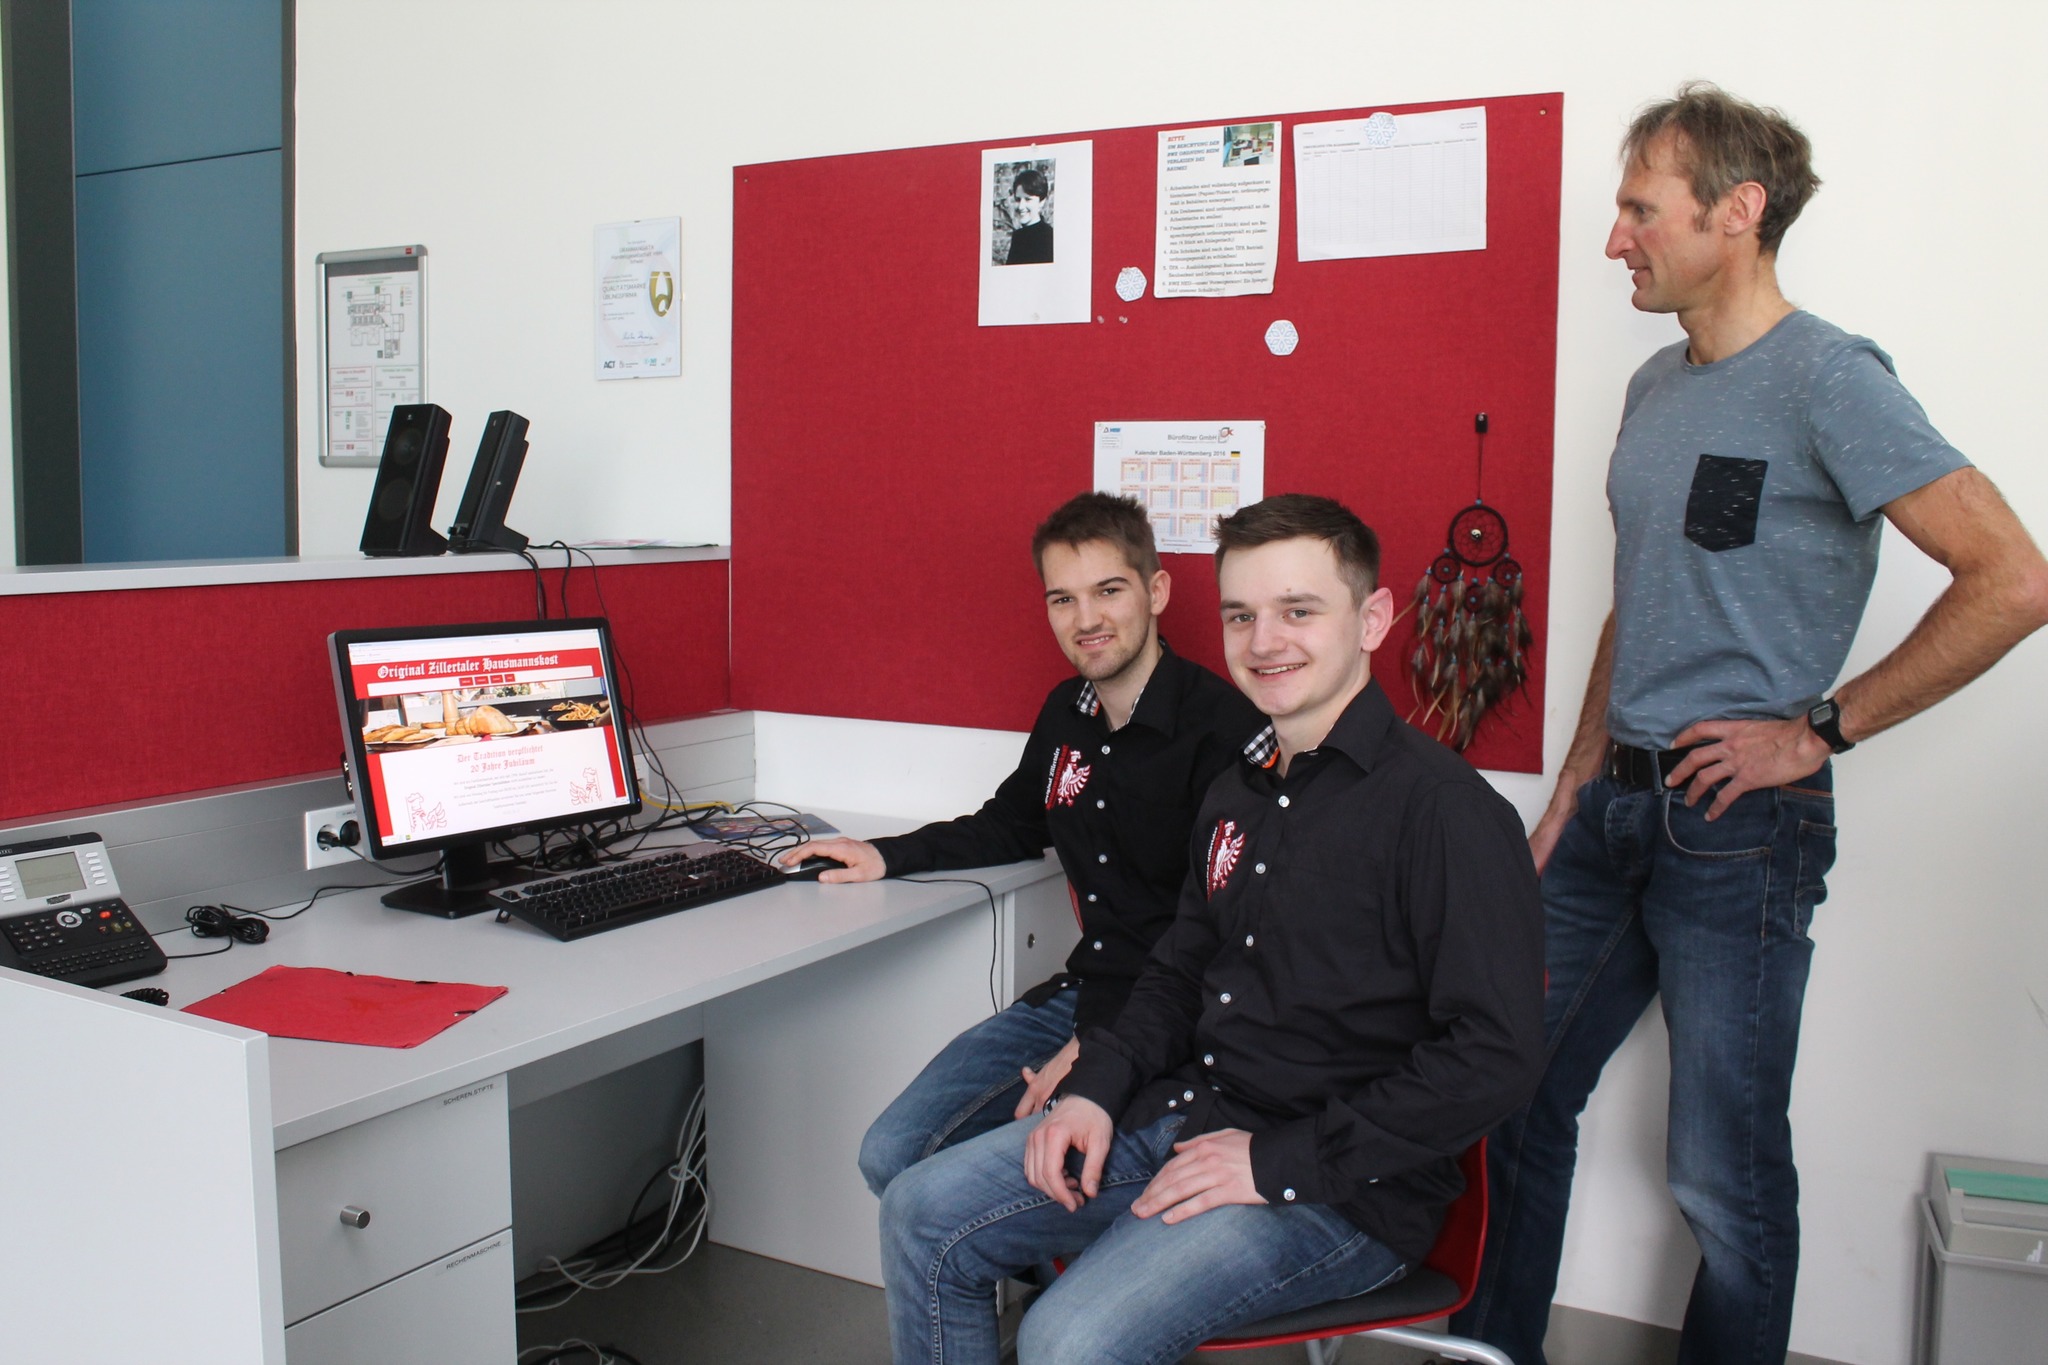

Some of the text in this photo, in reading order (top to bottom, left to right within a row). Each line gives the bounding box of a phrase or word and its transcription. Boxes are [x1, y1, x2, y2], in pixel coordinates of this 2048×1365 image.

[1159, 450, 1212, 458] Baden-Württemberg
[377, 653, 560, 681] Original Zillertaler Hausmannskost
[457, 744, 543, 763] Der Tradition verpflichtet
[481, 761, 501, 773] Jahre
[503, 757, 535, 770] Jubiläum
[446, 1240, 502, 1270] RECHENMASCHINE
